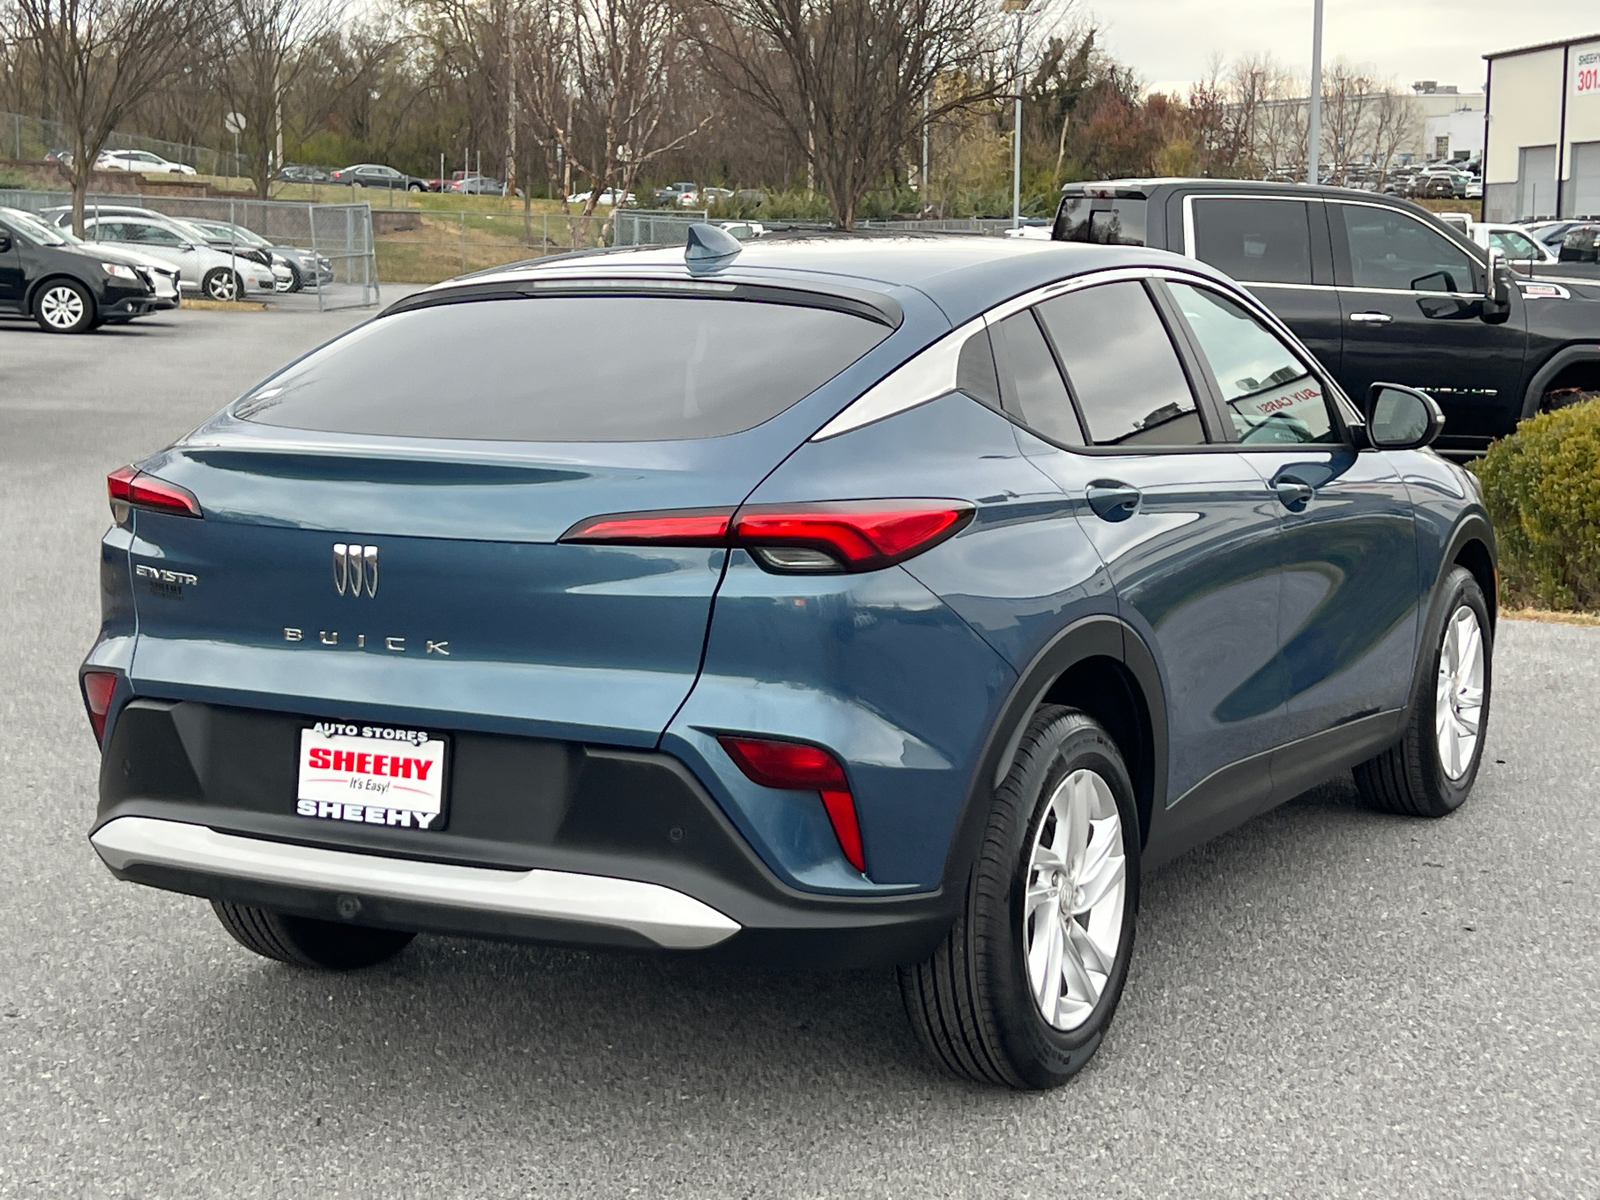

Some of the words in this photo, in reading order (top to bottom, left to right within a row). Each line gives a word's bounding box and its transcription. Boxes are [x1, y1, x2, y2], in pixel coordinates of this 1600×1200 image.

[284, 627, 450, 655] BUICK
[312, 722, 358, 736] AUTO
[362, 726, 429, 743] STORES
[308, 747, 434, 781] SHEEHY
[350, 777, 364, 790] It's
[365, 779, 391, 796] Easy!
[296, 799, 438, 829] SHEEHY
